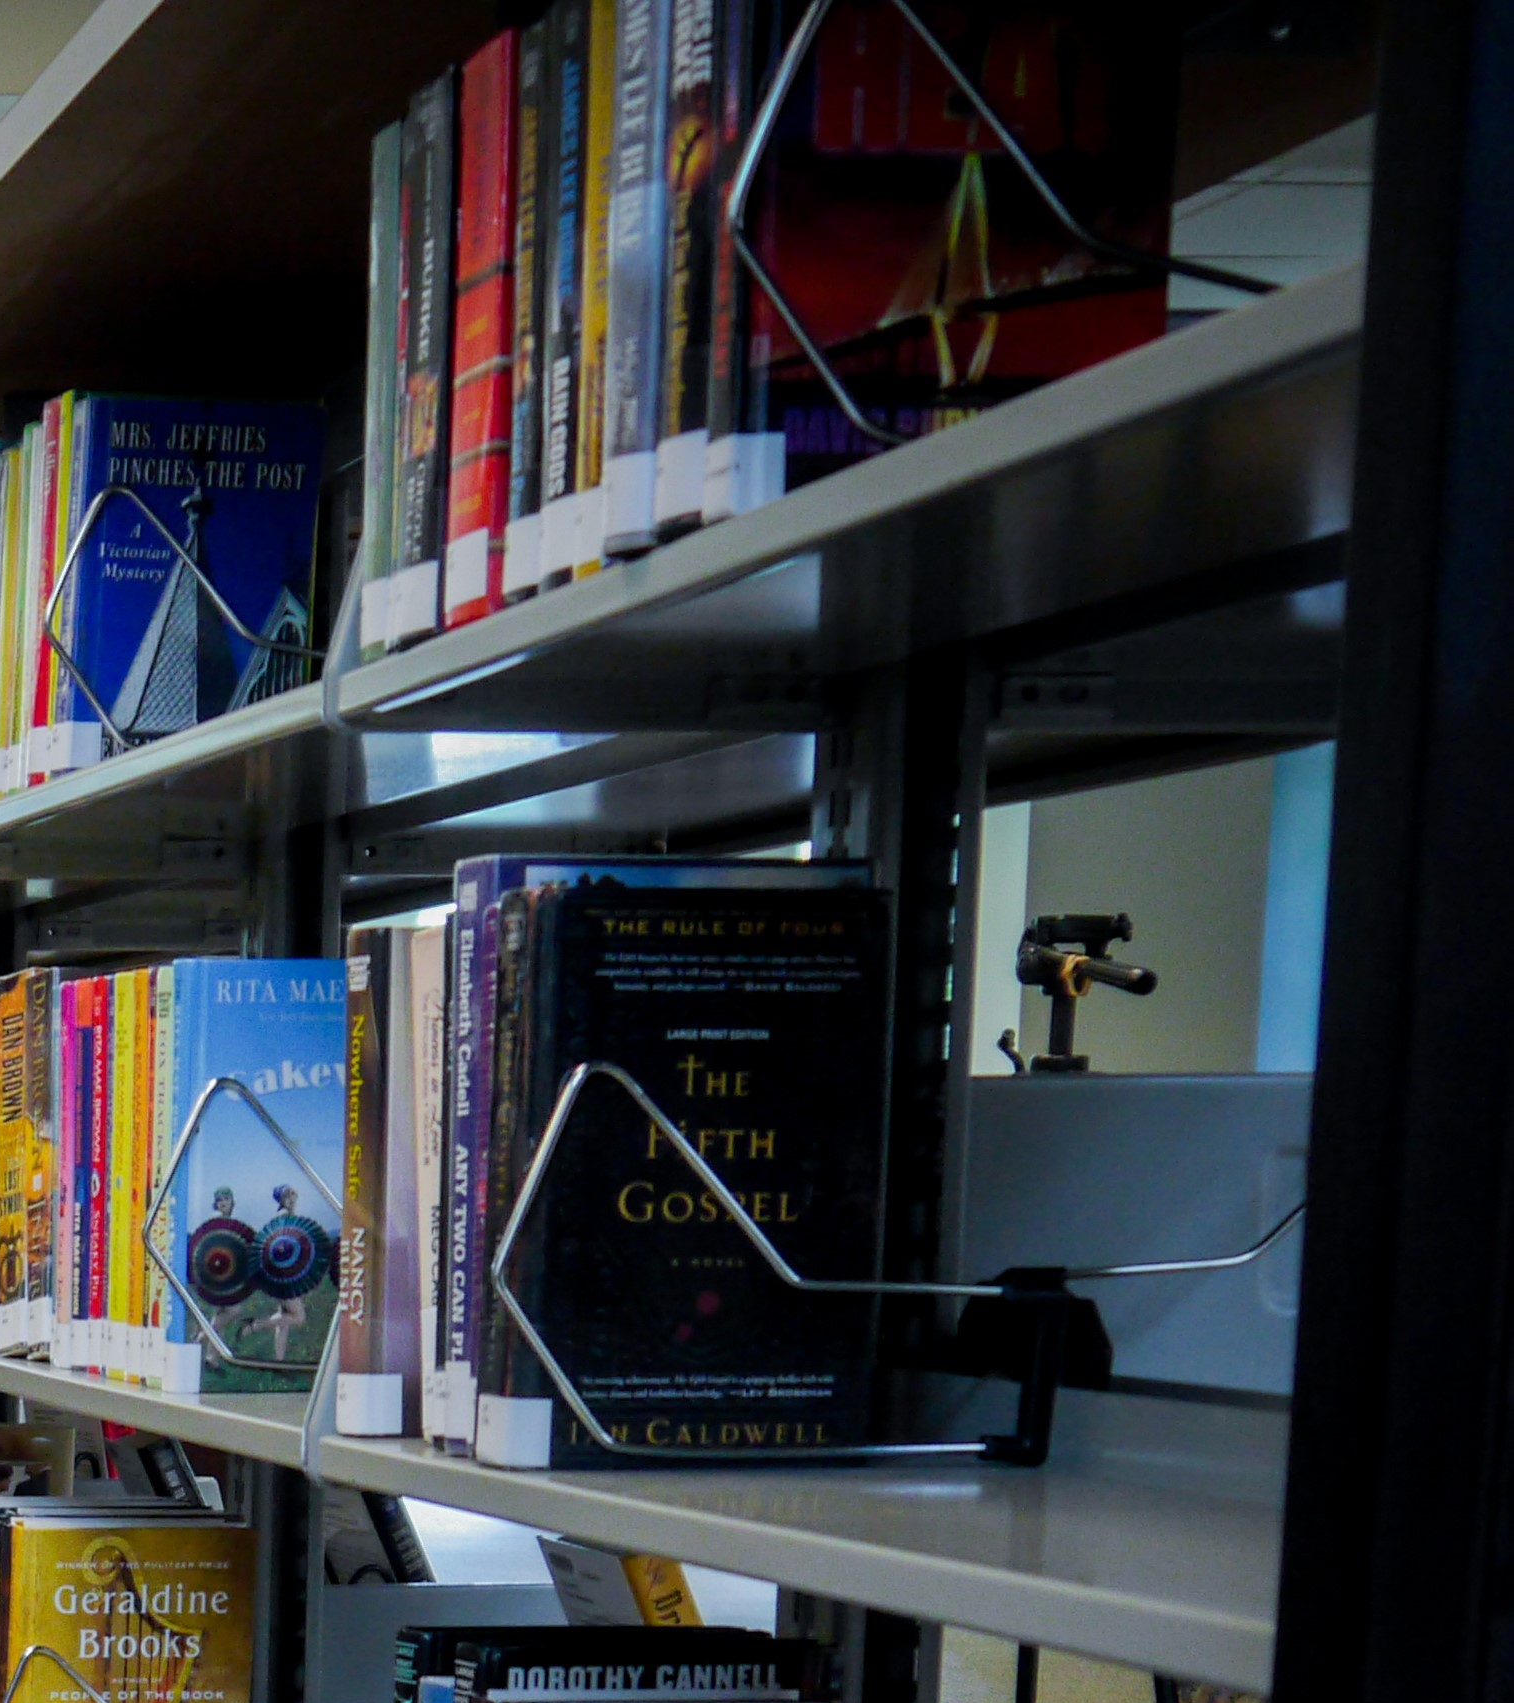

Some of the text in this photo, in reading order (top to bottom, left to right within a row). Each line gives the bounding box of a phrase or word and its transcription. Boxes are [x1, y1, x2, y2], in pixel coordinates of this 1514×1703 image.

[418, 240, 435, 362] BURKE
[111, 421, 266, 454] MRS. JEFFRIES
[551, 356, 571, 499] RAIN GODS
[109, 457, 306, 491] PINCHES THE POST
[129, 523, 142, 540] A
[99, 541, 171, 560] Victorian
[101, 562, 166, 583] Mystery
[603, 919, 846, 937] THE RULE OF FOUR
[217, 978, 346, 1004] RITA MAE
[1, 1013, 24, 1050] DAN
[455, 928, 474, 1117] Elizabeth Cadell
[1, 1055, 24, 1124] BROWN
[676, 1054, 754, 1097] THE
[92, 1024, 103, 1163] RITA MAE BROWN
[157, 1030, 167, 1160] FOX TRACKS
[346, 1014, 366, 1201] Nowhere Safe
[452, 1144, 469, 1326] ANY TWO CAN
[338, 1239, 352, 1311] BUSH
[350, 1226, 366, 1326] NANCY
[199, 1560, 231, 1569] PRIZE
[53, 1583, 230, 1615] Geraldine
[79, 1628, 202, 1659] Brooks
[507, 1663, 781, 1690] DOROTHY CANNELL
[179, 1690, 225, 1700] BOOK
